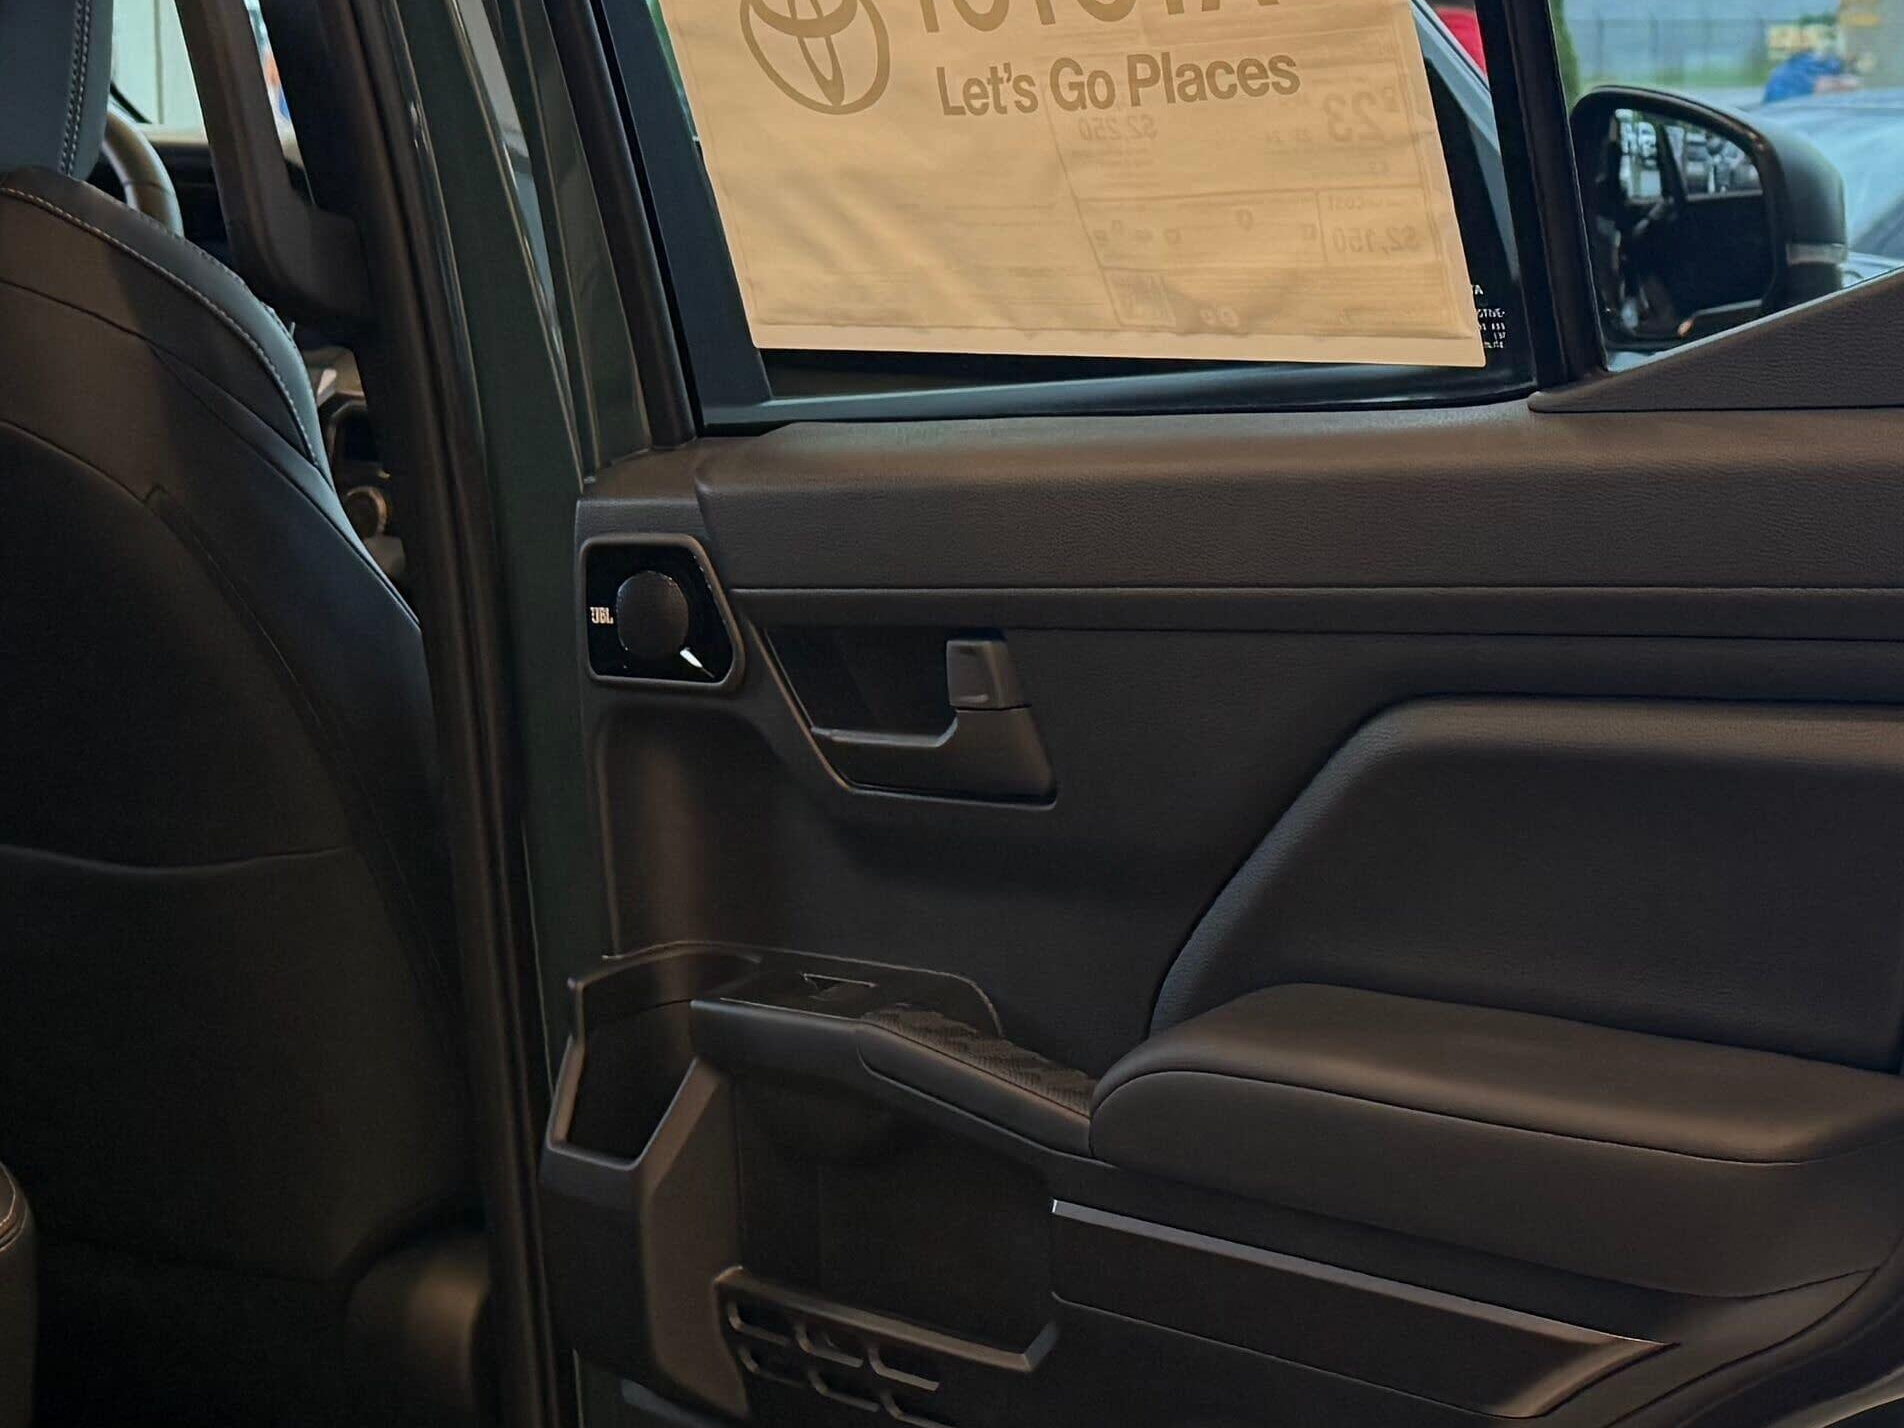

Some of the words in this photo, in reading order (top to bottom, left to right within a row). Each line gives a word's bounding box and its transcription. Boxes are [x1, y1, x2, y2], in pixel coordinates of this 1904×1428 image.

[936, 65, 1039, 117] Let's
[1050, 58, 1116, 111] Go
[1127, 53, 1301, 108] Places
[589, 606, 614, 625] JBL
